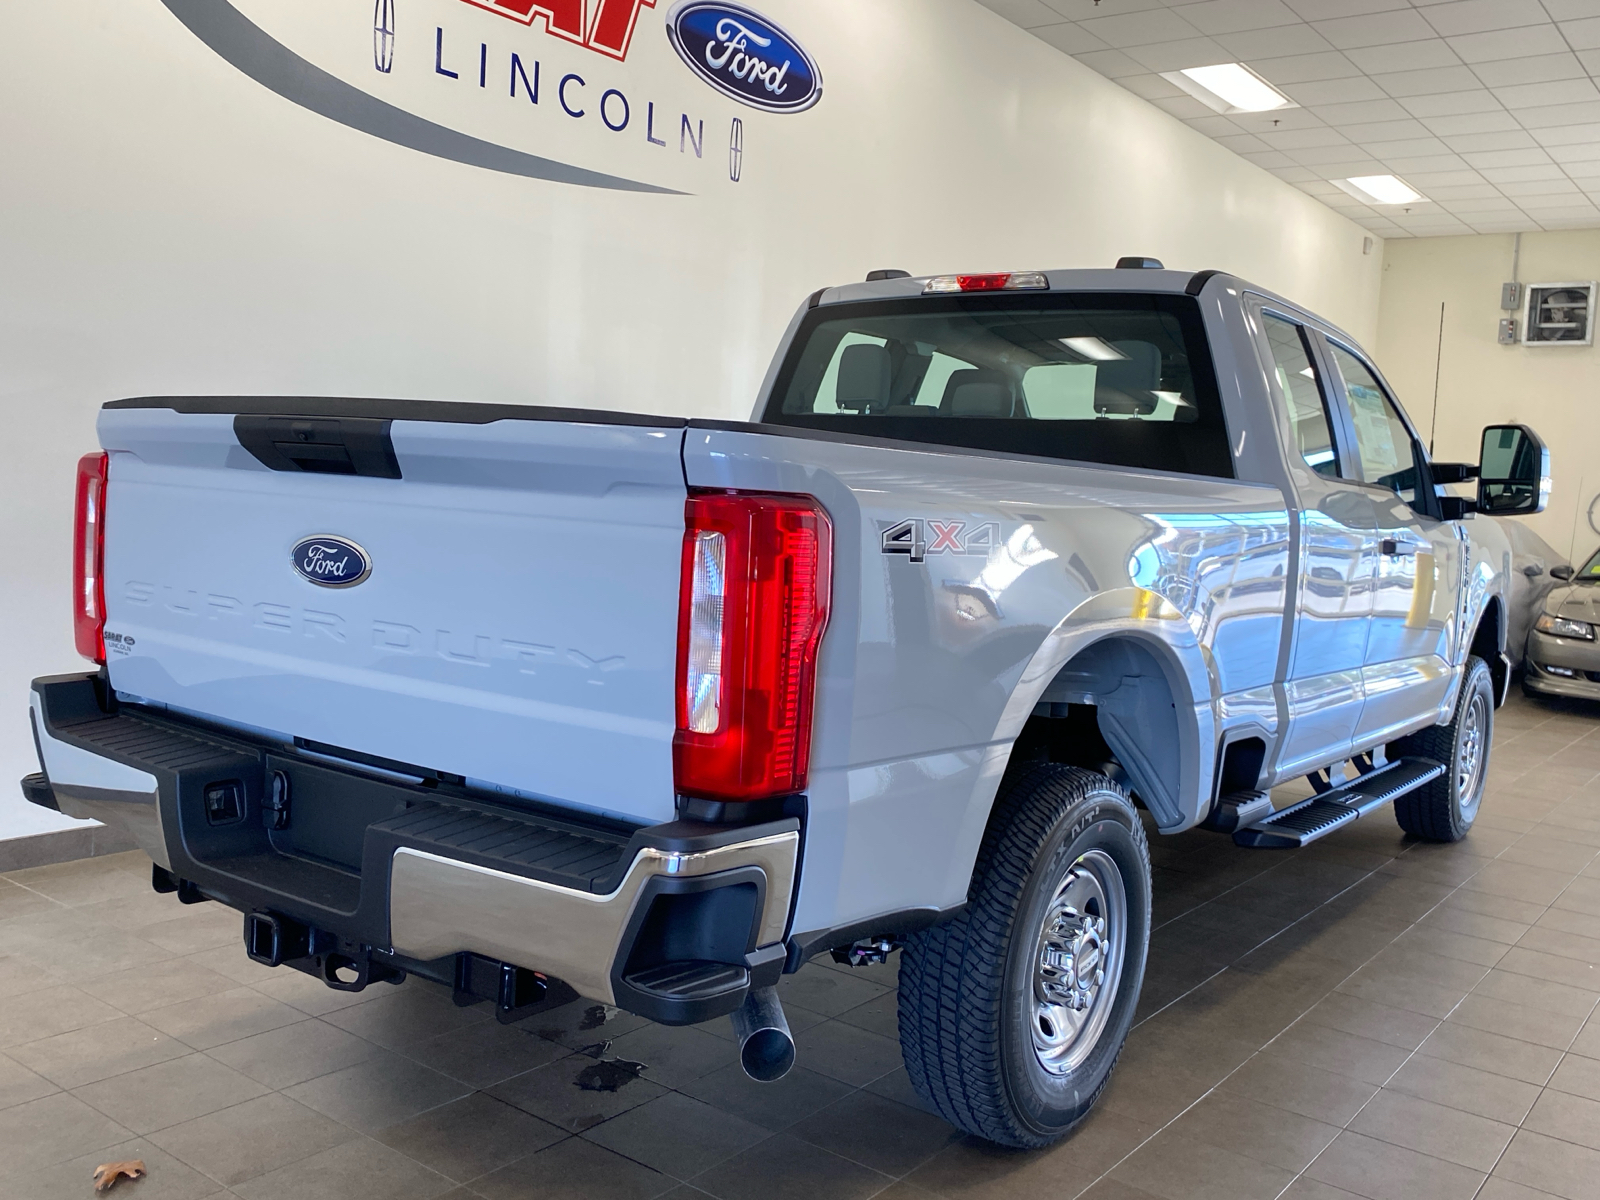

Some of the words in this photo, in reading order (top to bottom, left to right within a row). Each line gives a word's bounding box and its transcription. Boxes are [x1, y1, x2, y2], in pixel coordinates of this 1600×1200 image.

[435, 26, 704, 159] LINCOLN
[705, 17, 790, 96] Ford
[303, 544, 349, 576] Ford
[124, 579, 347, 644] SUPER
[371, 618, 627, 686] DUTY
